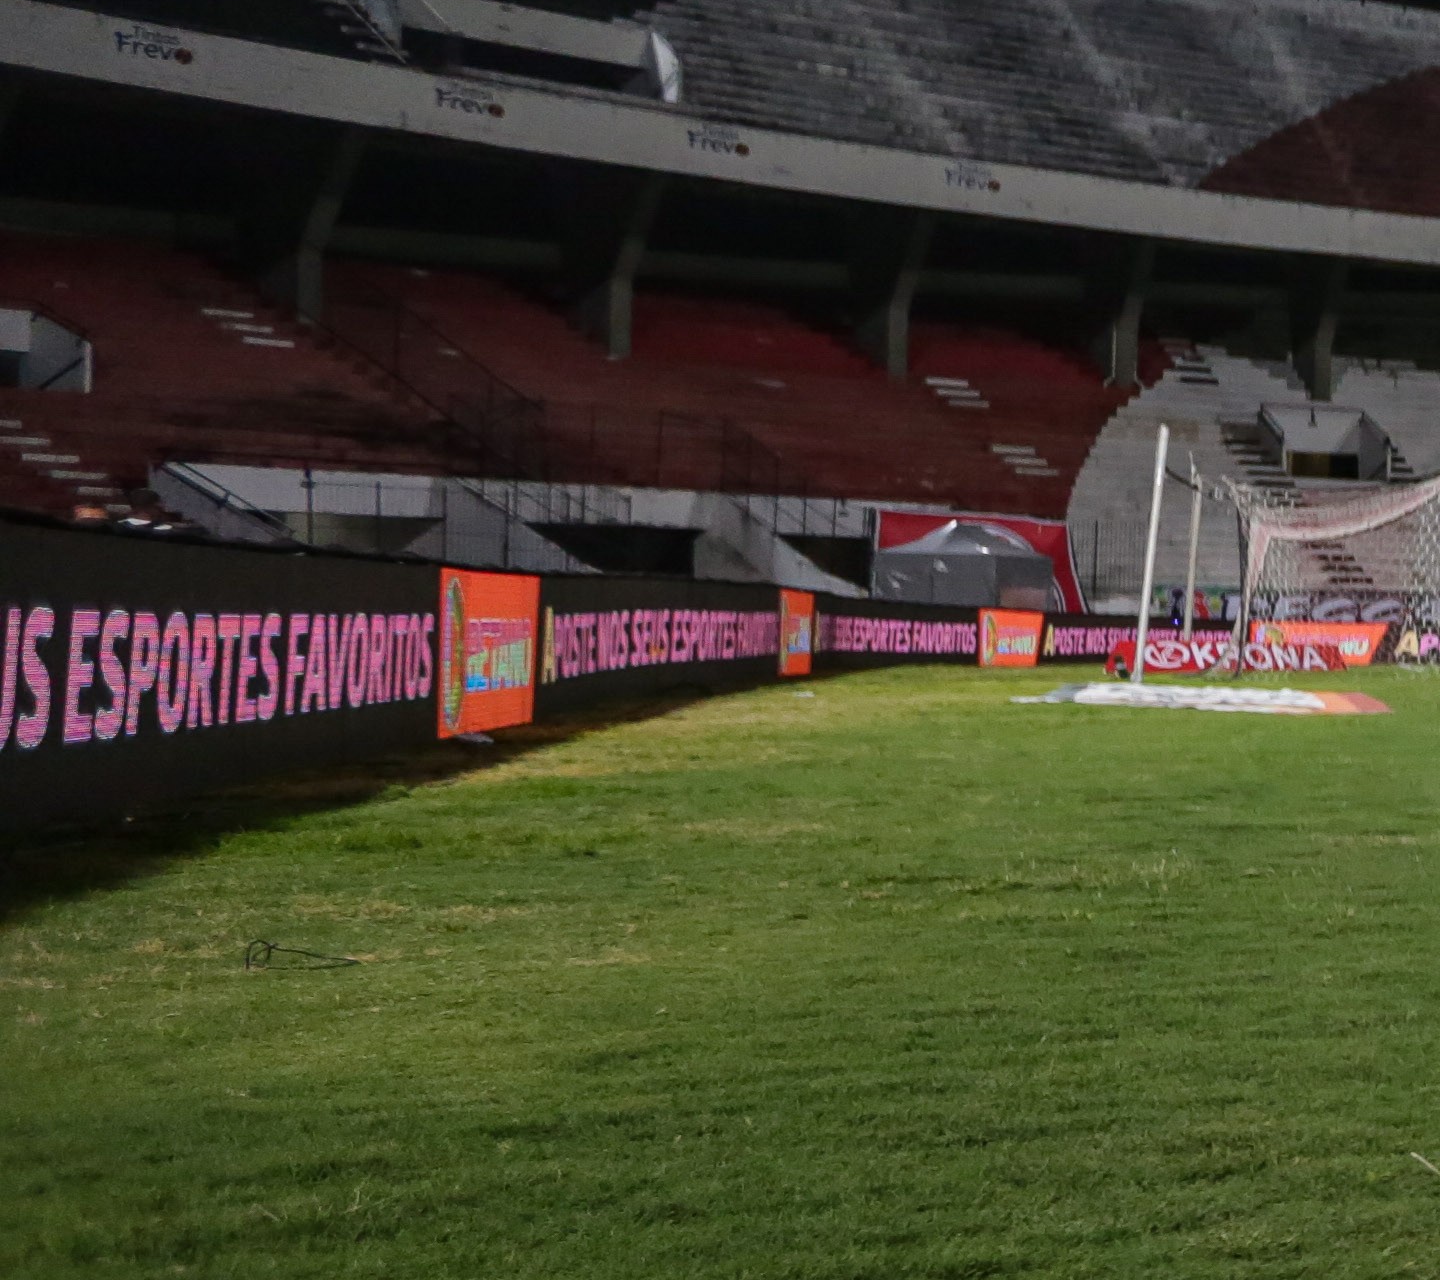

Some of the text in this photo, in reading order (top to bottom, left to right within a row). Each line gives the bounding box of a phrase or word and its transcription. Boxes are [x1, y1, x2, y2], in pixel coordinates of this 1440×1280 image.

[64, 611, 282, 743] ESPORTES
[284, 613, 434, 715] FAVORITOS
[913, 621, 977, 654] FAVORITOS
